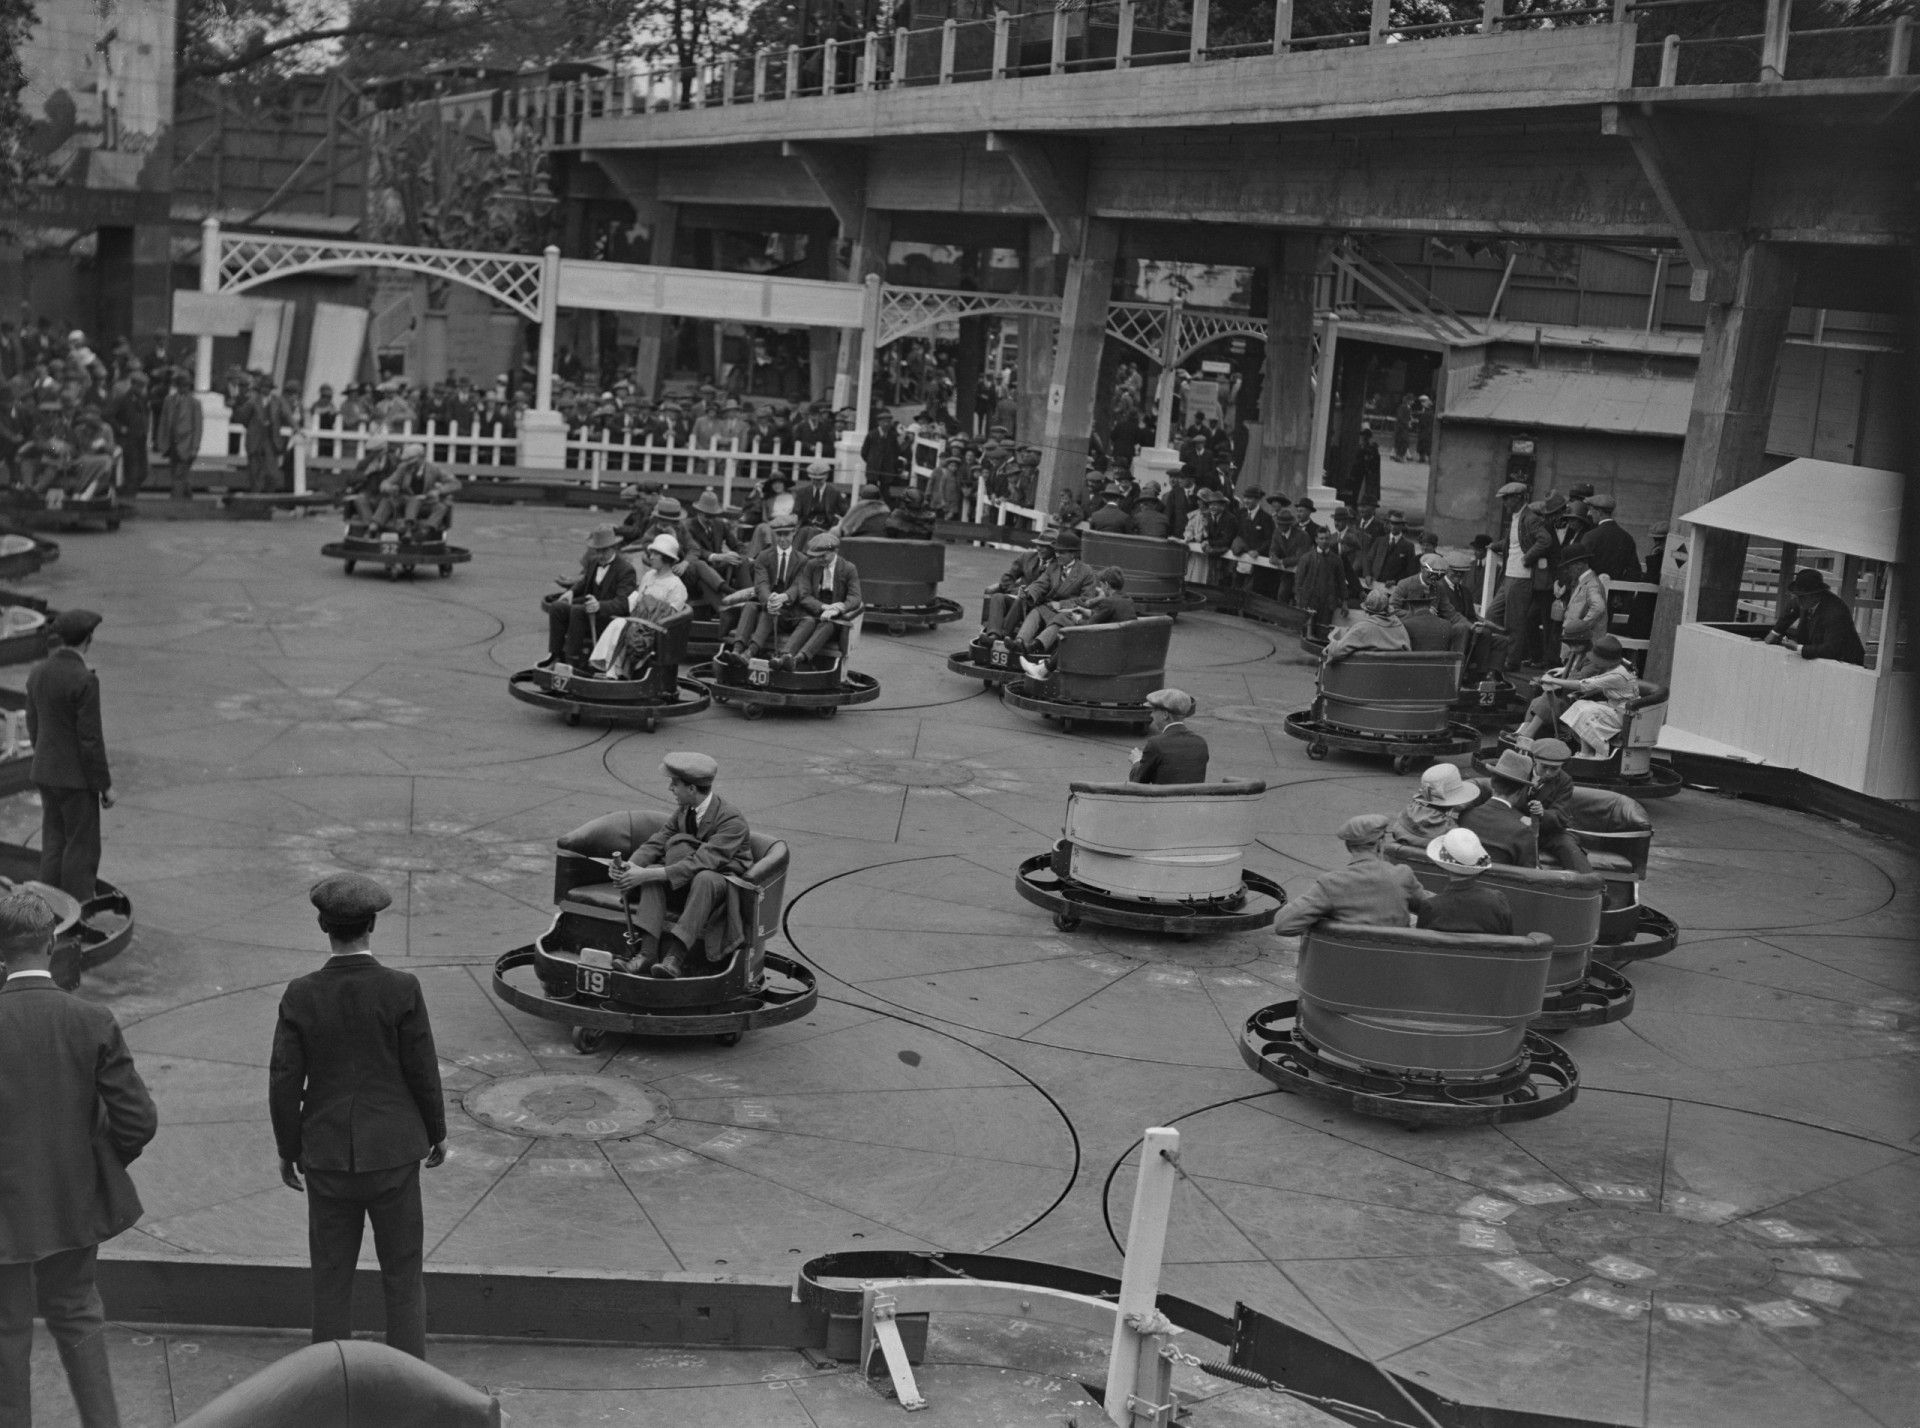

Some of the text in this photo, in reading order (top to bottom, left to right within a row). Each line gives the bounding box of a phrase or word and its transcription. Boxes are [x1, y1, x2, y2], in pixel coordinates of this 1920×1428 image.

[992, 652, 1008, 665] 39
[553, 675, 568, 690] 37
[748, 670, 767, 684] 40
[1479, 692, 1494, 704] 23
[584, 970, 604, 993] 19
